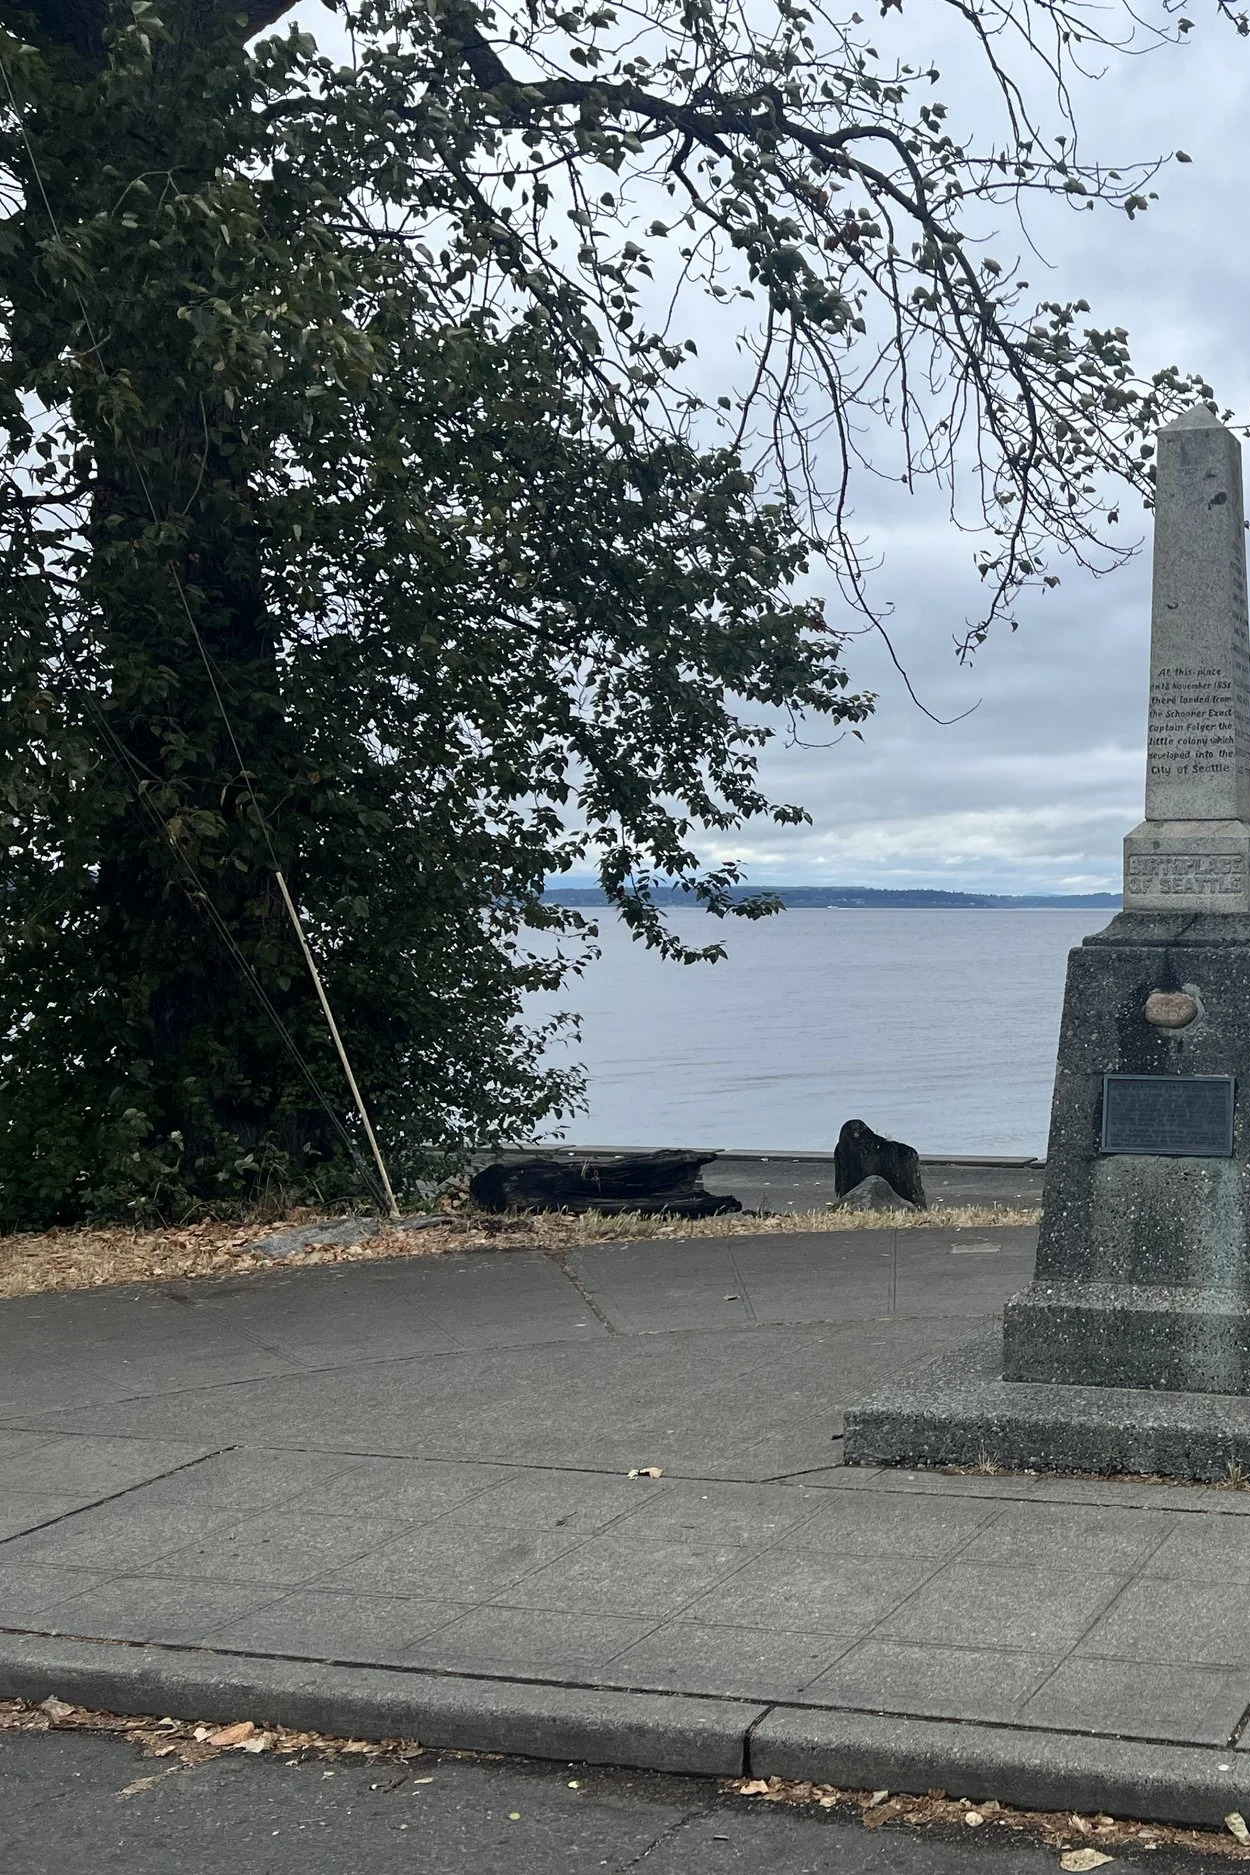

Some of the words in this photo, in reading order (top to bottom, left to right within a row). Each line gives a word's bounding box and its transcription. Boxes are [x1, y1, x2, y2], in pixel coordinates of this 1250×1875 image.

[1159, 668, 1170, 677] At
[1174, 668, 1192, 676] this
[1197, 668, 1221, 679] place
[1172, 682, 1211, 690] November
[1214, 681, 1231, 689] 1851
[1151, 696, 1176, 705] there
[1180, 695, 1209, 703] landed
[1212, 696, 1231, 704] from
[1150, 710, 1162, 718] the
[1166, 710, 1206, 718] Schooner
[1208, 709, 1233, 717] Exact
[1149, 725, 1183, 733] Captain
[1149, 737, 1173, 745] little
[1178, 737, 1208, 746] colony
[1210, 736, 1234, 744] which
[1149, 751, 1191, 760] developed
[1195, 750, 1213, 759] into
[1219, 750, 1233, 758] the
[1151, 766, 1171, 775] City
[1177, 765, 1188, 774] of
[1192, 764, 1230, 773] Seattle
[1129, 855, 1244, 875] BIRTHPLACE
[1130, 876, 1153, 894] OF
[1160, 876, 1242, 894] SEATTLE
